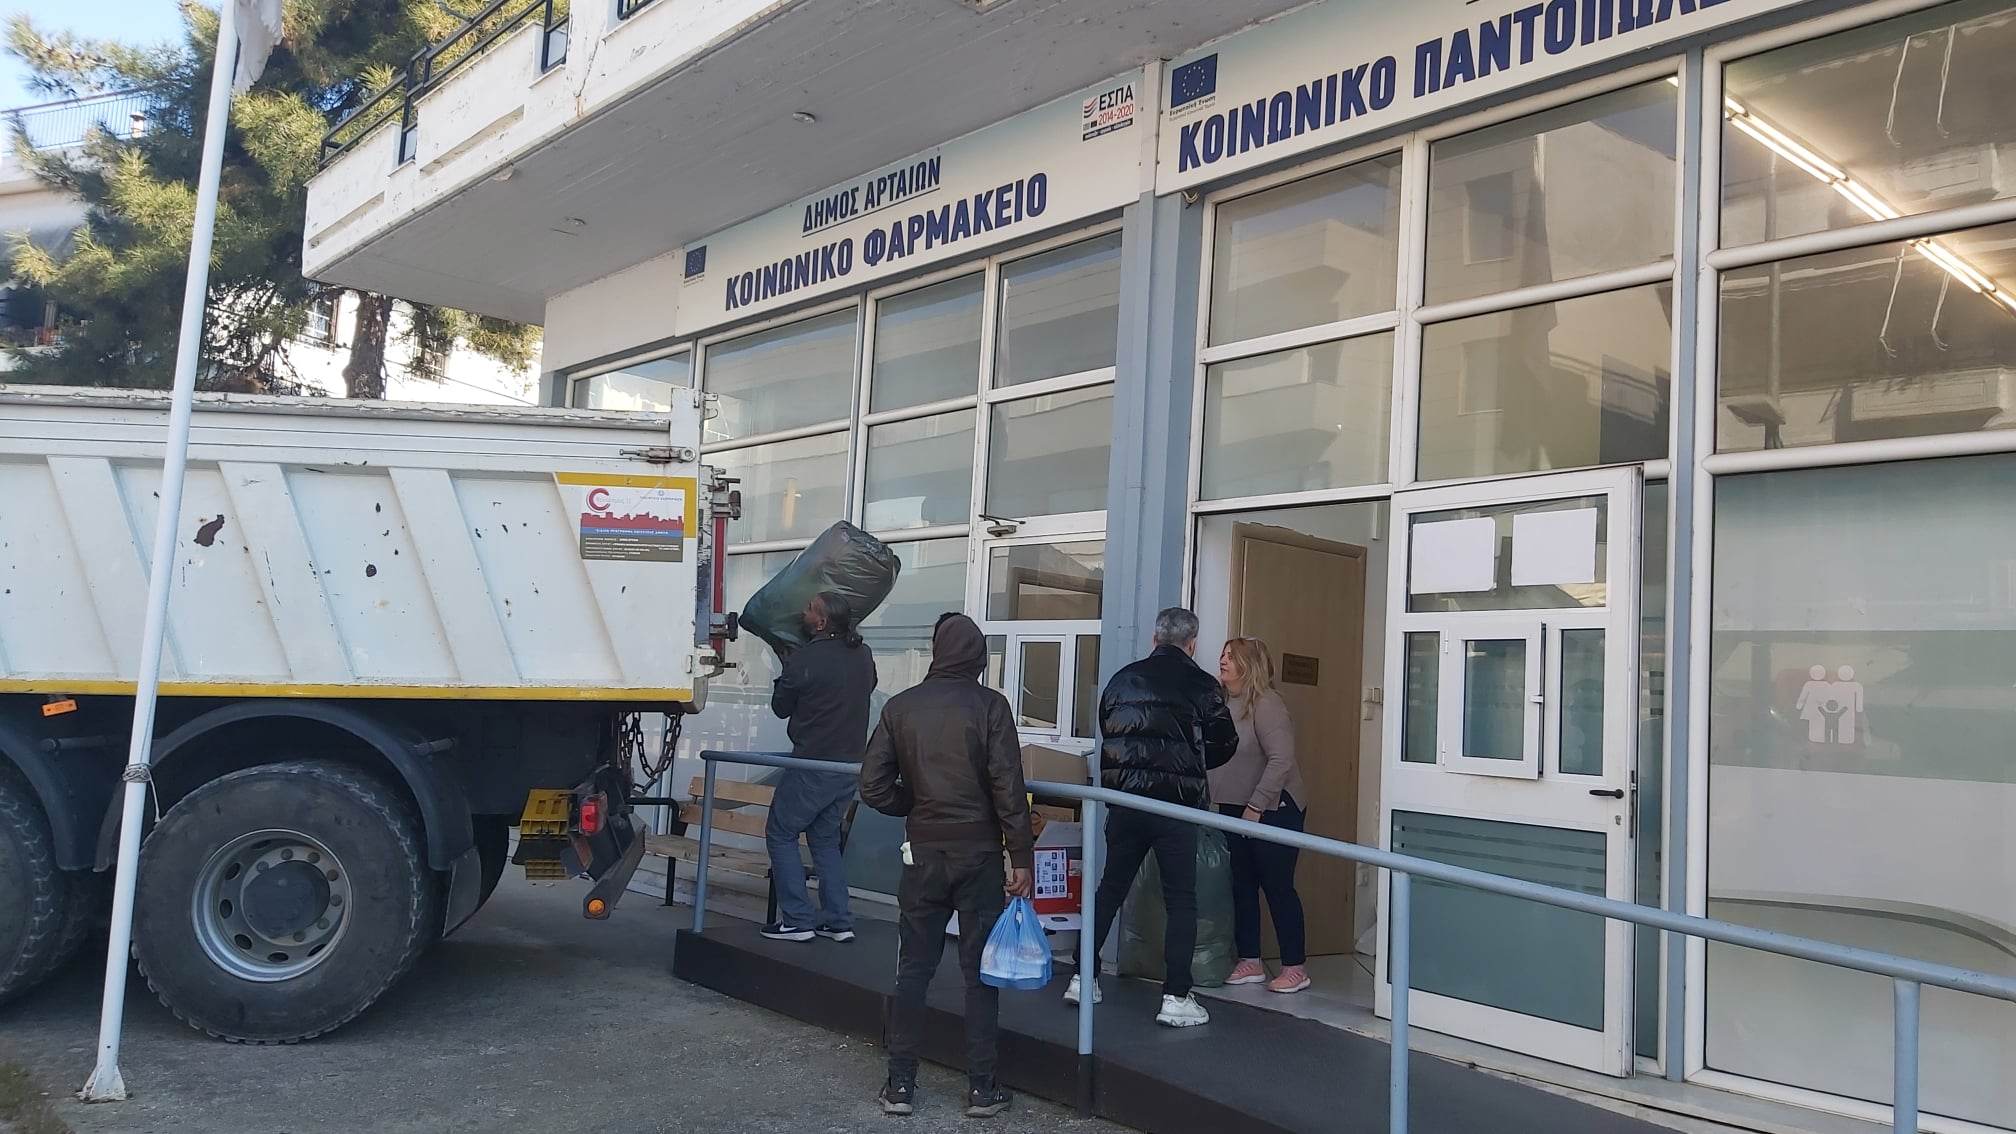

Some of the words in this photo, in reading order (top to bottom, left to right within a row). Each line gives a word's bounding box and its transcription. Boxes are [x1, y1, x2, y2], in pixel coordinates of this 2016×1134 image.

[1098, 103, 1134, 126] 2014-2020
[1099, 84, 1134, 111] ΕΣΠΑ
[1179, 55, 1397, 173] ΚΟΙΝΩΝΙΚΟ
[1413, 0, 1729, 98] ΠΑΝΤΟΠΩ
[802, 187, 860, 232] ΔΗΜΟΣ
[863, 155, 941, 209] ΑΡΤΑΙΩΝ
[725, 238, 854, 311] ΚΟΙΝΩΝΙΚΟ
[863, 172, 1048, 267] ΦΑΡΜΑΚΕΙΟ
